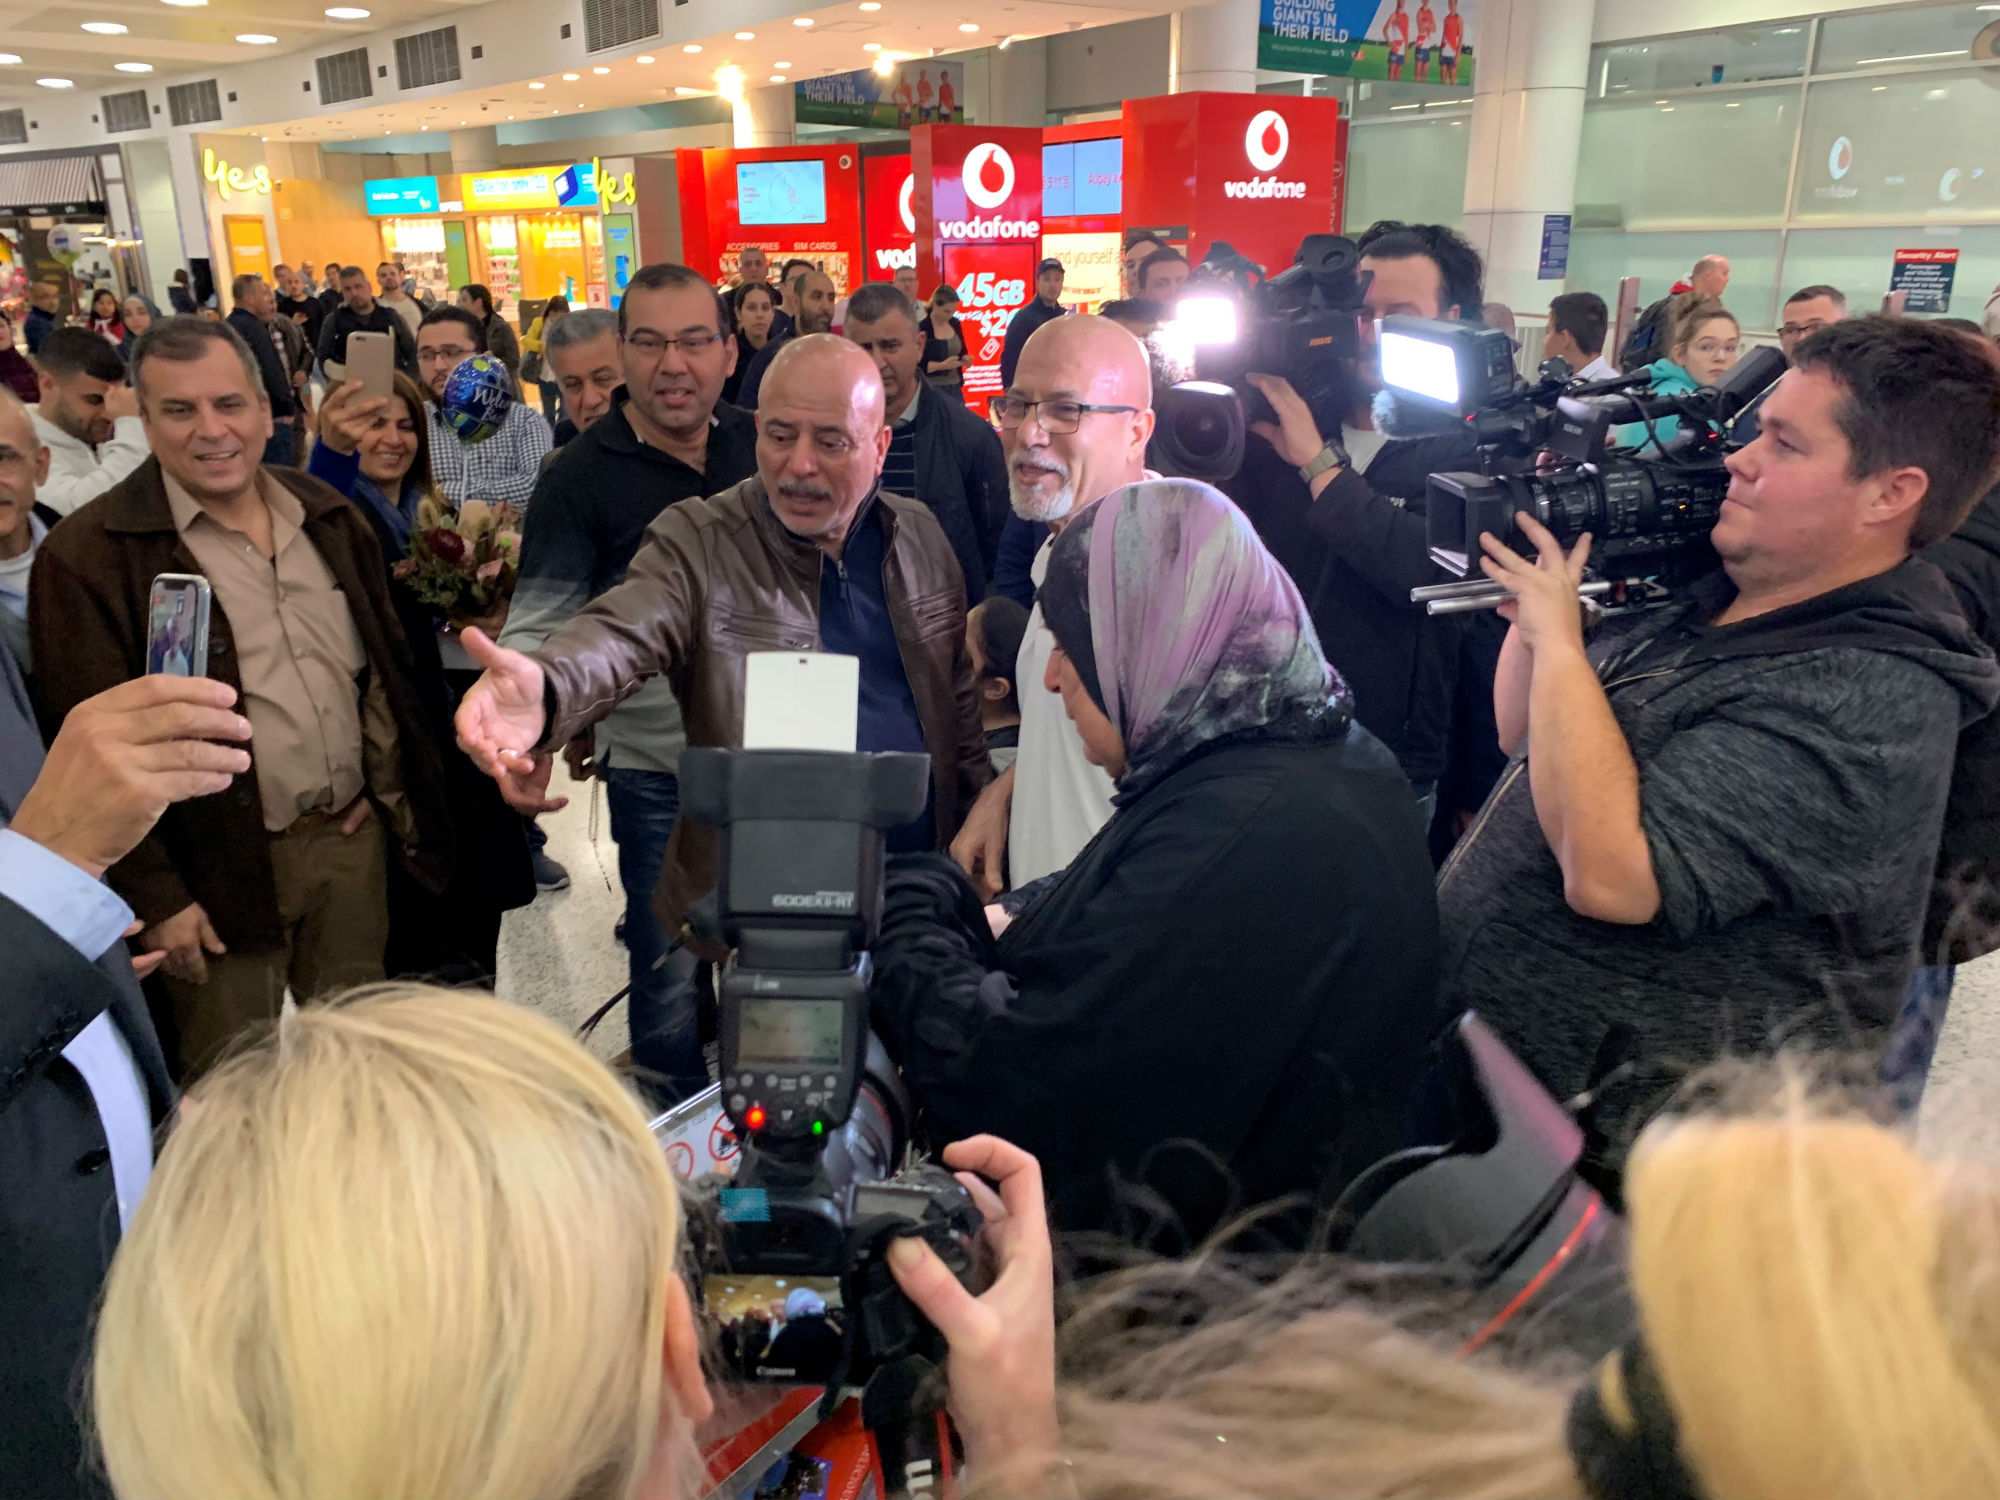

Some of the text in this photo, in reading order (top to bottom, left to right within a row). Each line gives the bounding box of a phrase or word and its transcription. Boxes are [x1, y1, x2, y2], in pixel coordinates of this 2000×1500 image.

[1272, 6, 1337, 27] GIANTS IN
[1272, 21, 1350, 44] THEIR FIELD
[1224, 176, 1307, 198] vodafone
[939, 215, 1041, 239] vodafone
[809, 241, 838, 251] CARDS
[956, 272, 1025, 307] 45GB
